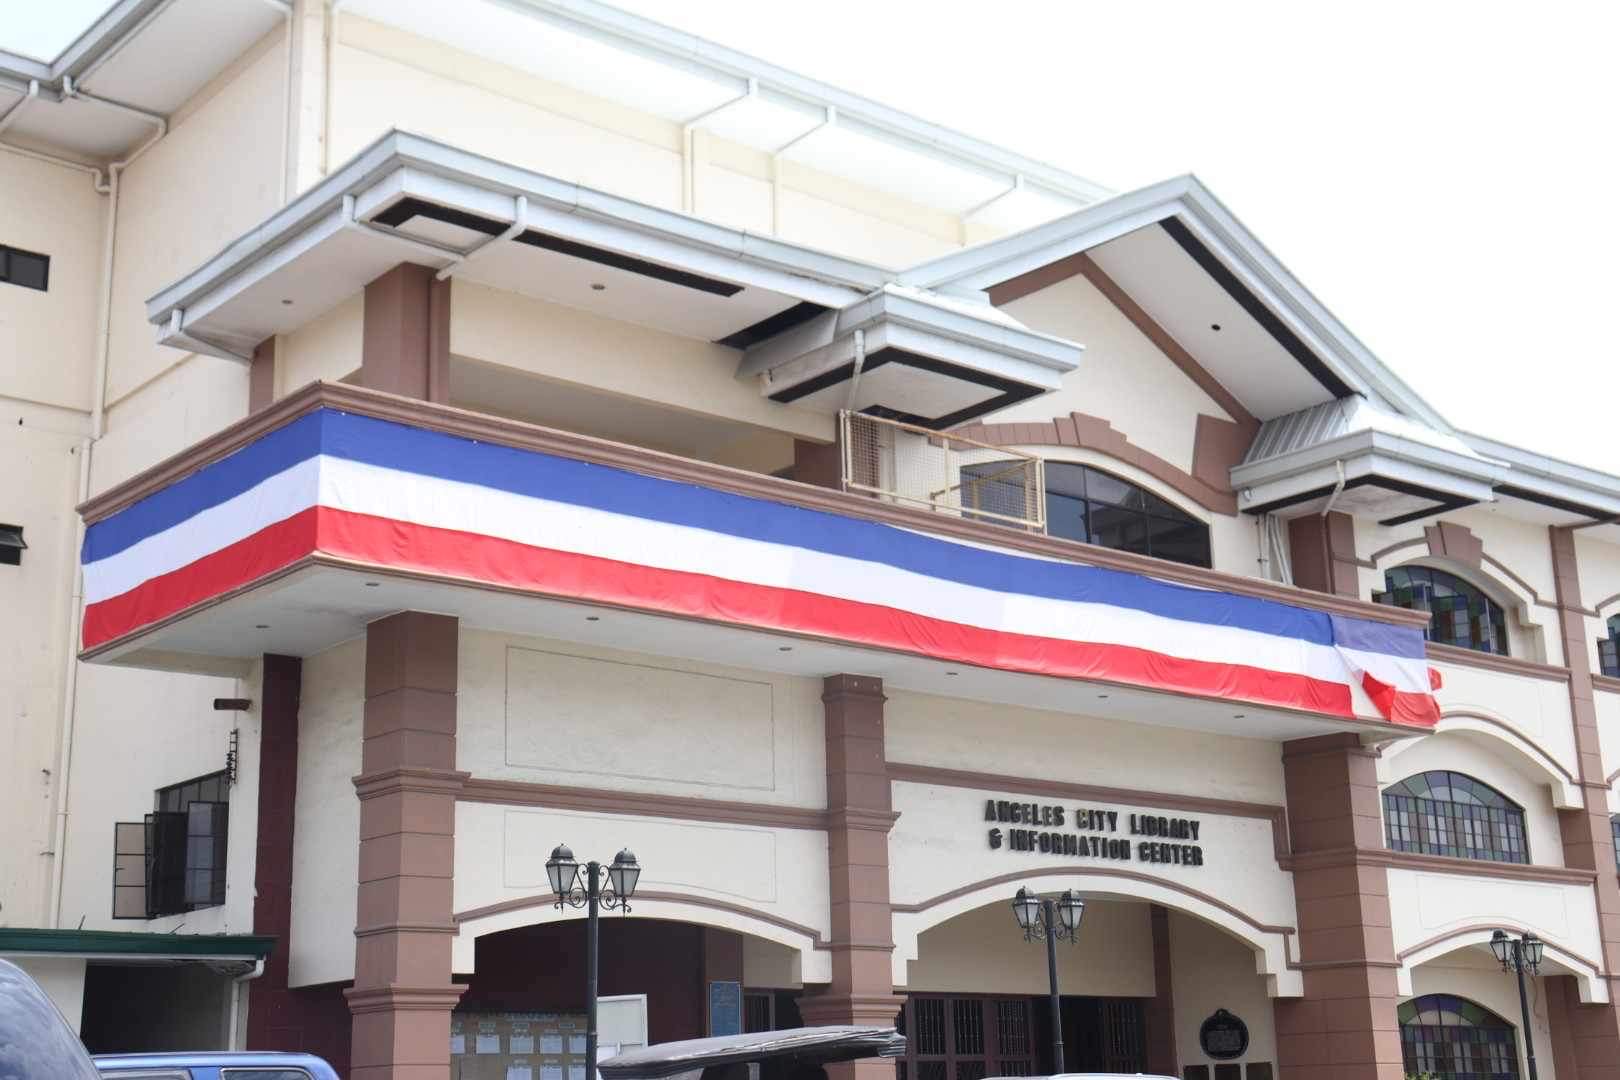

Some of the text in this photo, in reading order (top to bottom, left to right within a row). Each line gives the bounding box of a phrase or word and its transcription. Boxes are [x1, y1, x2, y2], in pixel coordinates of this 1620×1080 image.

[985, 799, 1200, 841] ANGELES CITY LIBRARY
[1009, 829, 1131, 860] INFORMATION
[1138, 842, 1204, 866] CENTER
